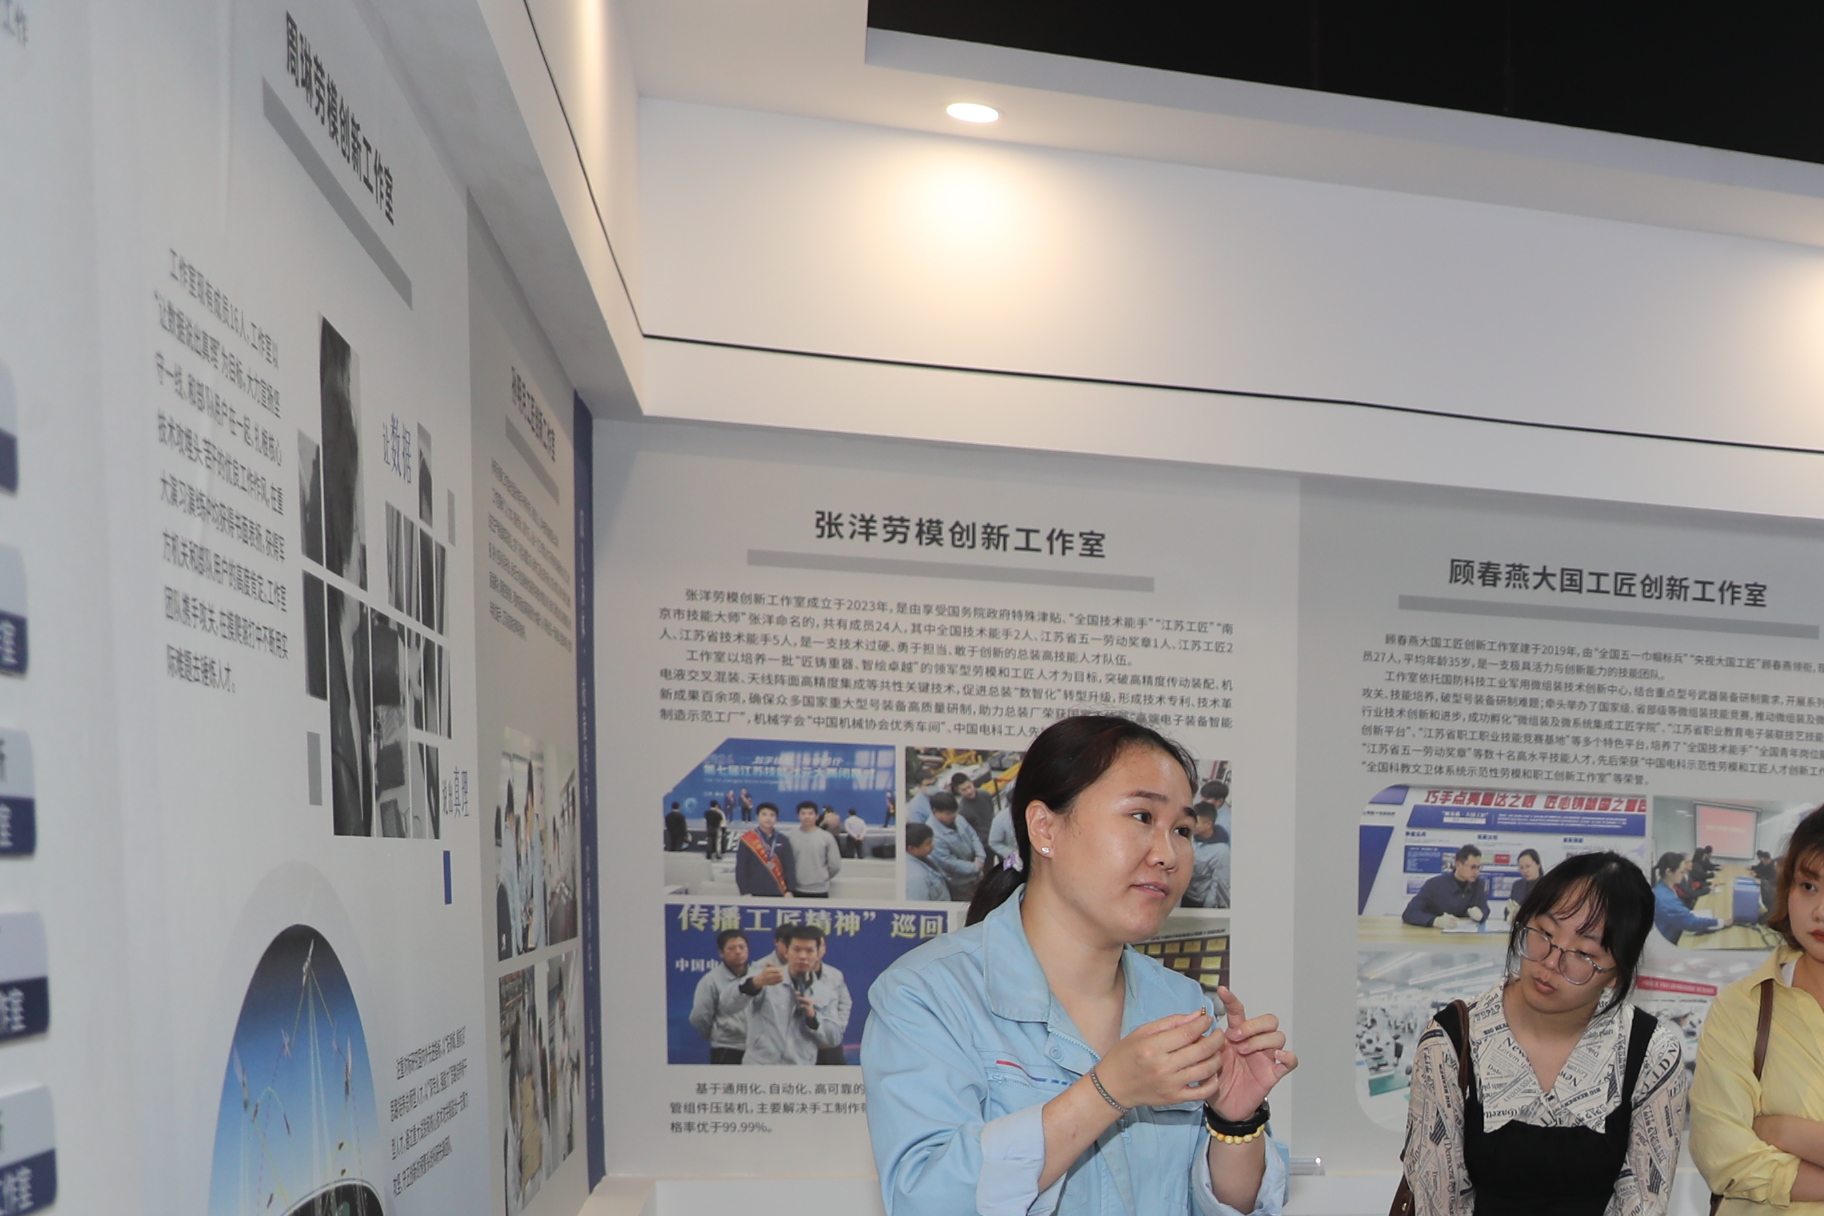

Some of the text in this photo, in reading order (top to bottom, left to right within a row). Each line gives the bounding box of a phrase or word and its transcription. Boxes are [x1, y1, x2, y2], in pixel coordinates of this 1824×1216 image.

[814, 510, 1107, 559] 张洋劳模创新工作室
[1449, 558, 1768, 608] 顾春燕大国工匠创新工作室
[670, 1121, 772, 1135] 格率优于99.99%。
